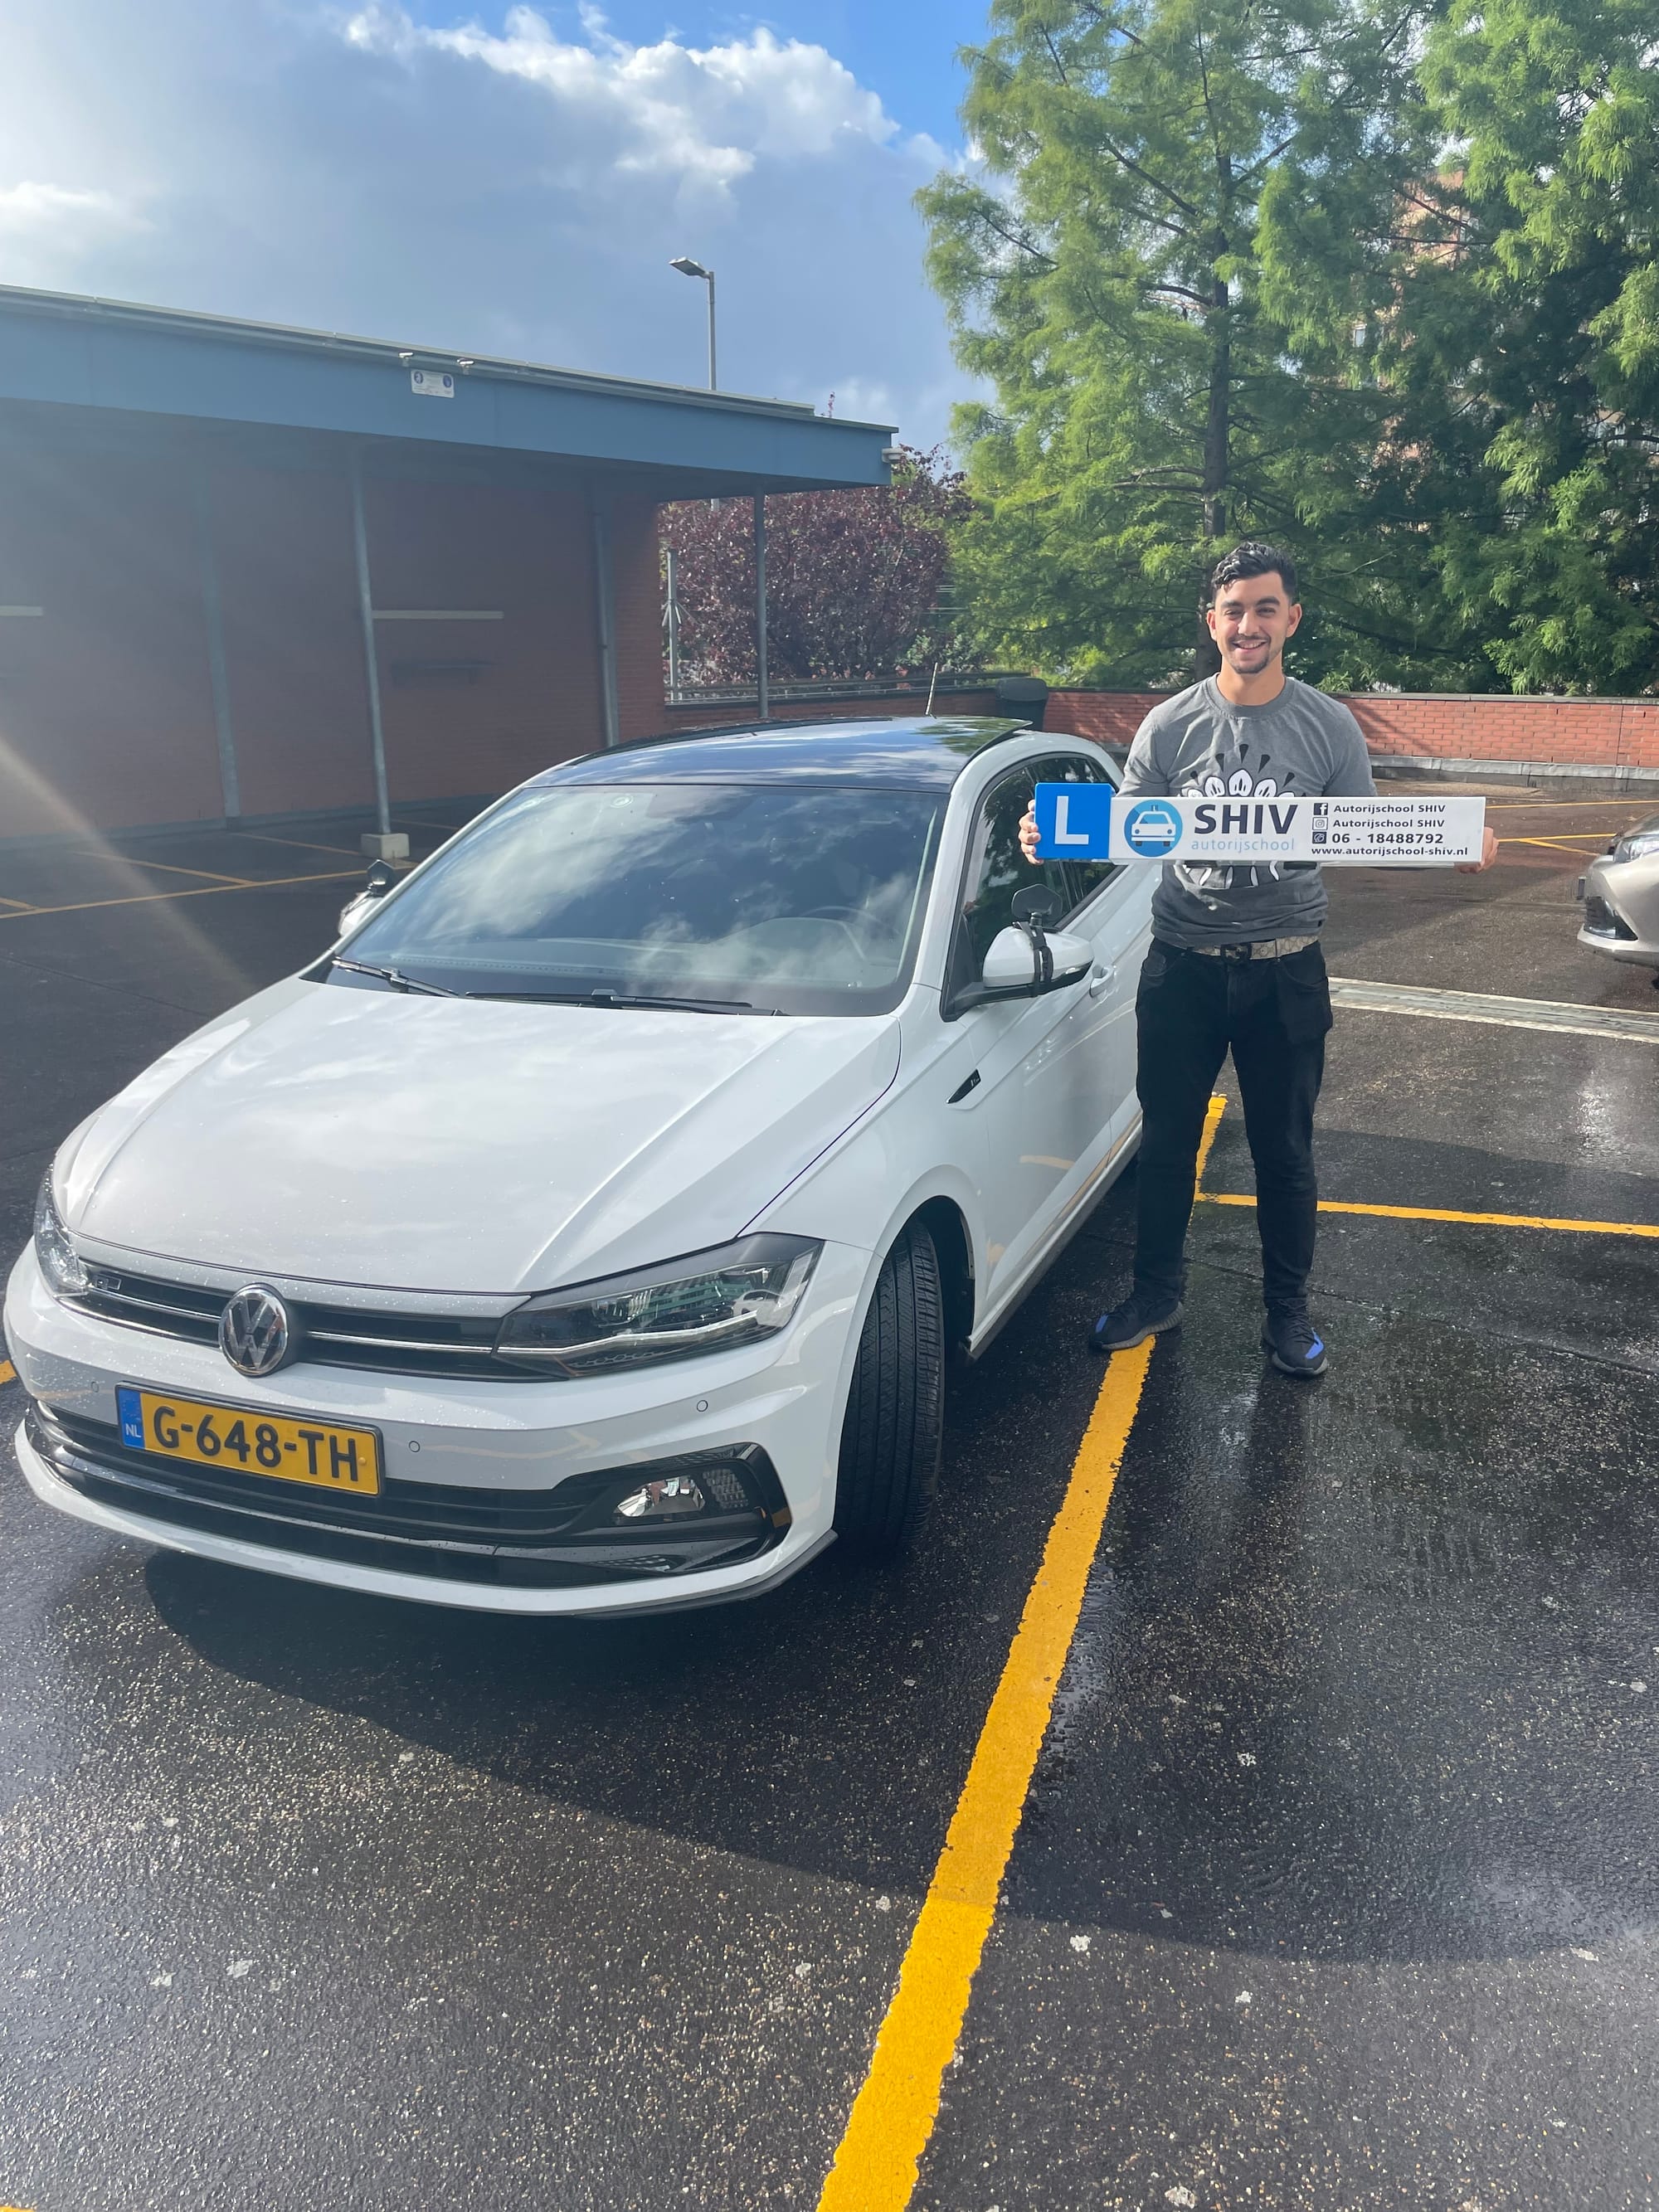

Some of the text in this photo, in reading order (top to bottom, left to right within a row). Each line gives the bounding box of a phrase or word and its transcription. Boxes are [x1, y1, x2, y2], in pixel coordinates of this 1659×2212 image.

[1333, 805, 1446, 814] Autorijschool SHIV
[1054, 795, 1089, 845] L
[1194, 804, 1297, 834] SHIV
[1332, 819, 1445, 829] Autorijschool SHIV
[1191, 838, 1294, 853] autorijschool
[1331, 834, 1350, 843] 06
[1367, 834, 1444, 843] 18488792
[1311, 847, 1468, 856] www.autorijschool-shiv.nl
[124, 1423, 142, 1438] NL
[153, 1406, 358, 1482] G-648-TH
